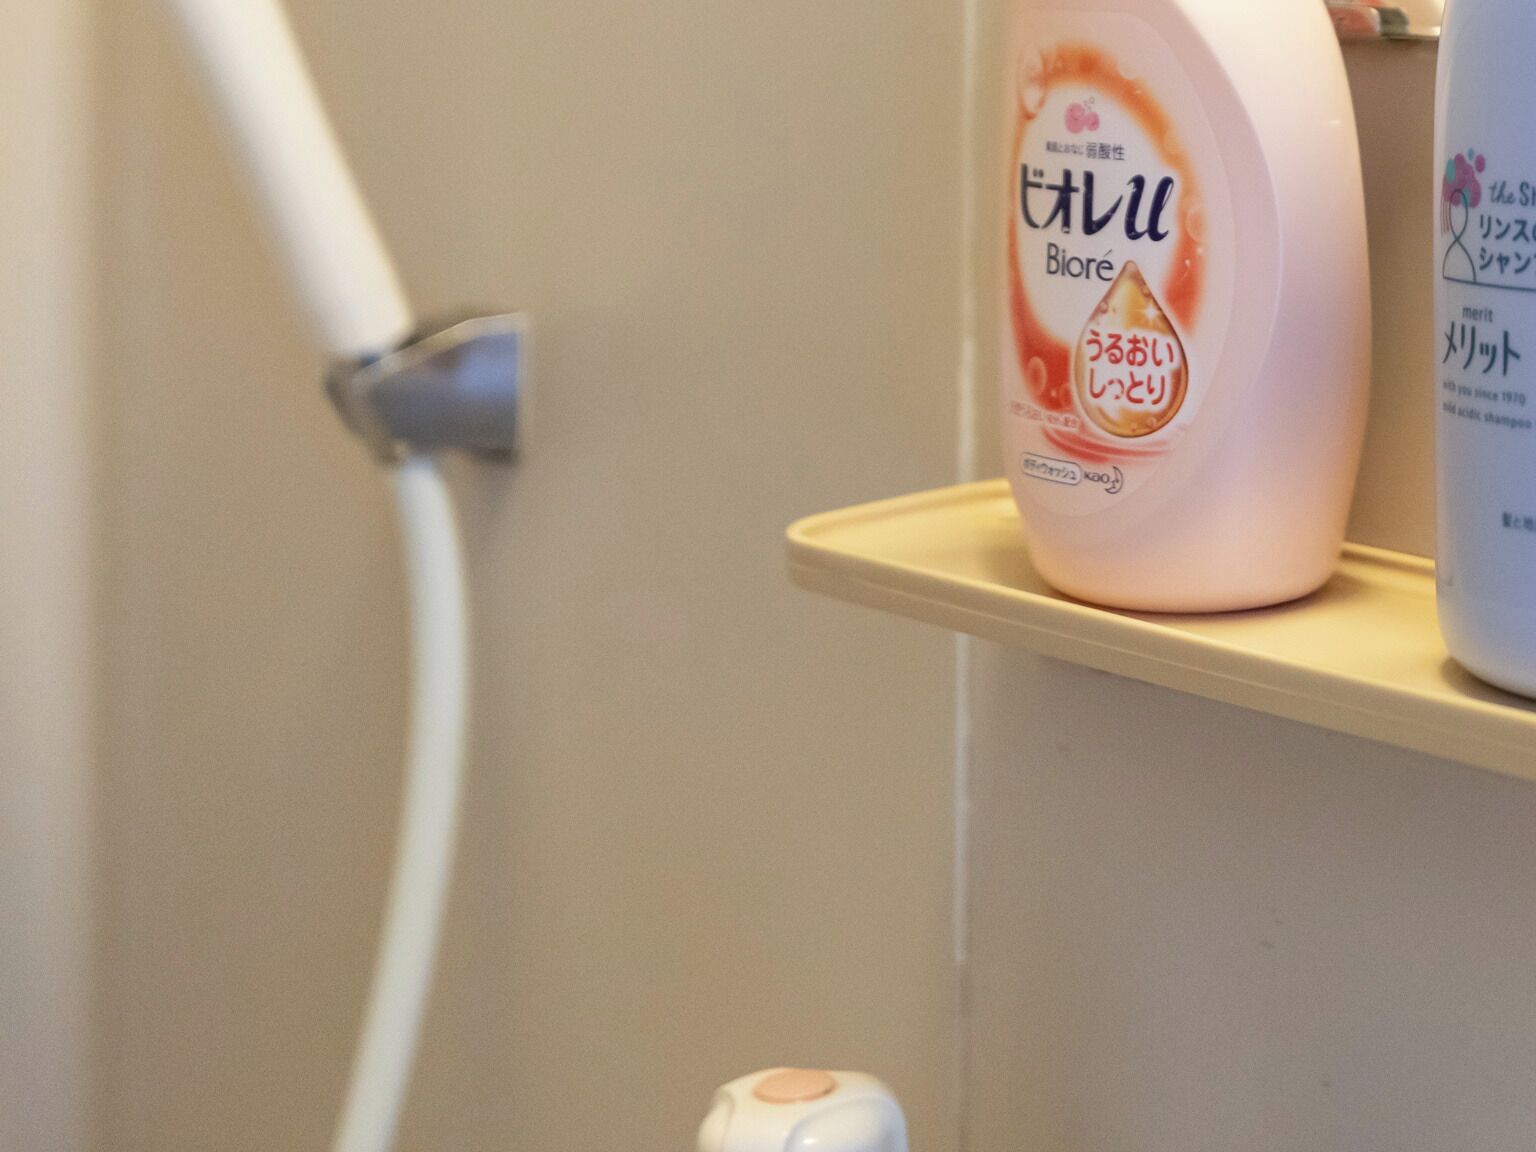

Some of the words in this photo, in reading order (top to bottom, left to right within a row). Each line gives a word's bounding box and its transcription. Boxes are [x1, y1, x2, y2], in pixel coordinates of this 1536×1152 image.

[1046, 242, 1114, 281] Bioré
[1462, 305, 1494, 323] merit
[1086, 329, 1174, 367] うるおい
[1443, 320, 1521, 377] メリット
[1089, 367, 1166, 406] しっとり
[1484, 411, 1532, 429] shampoo
